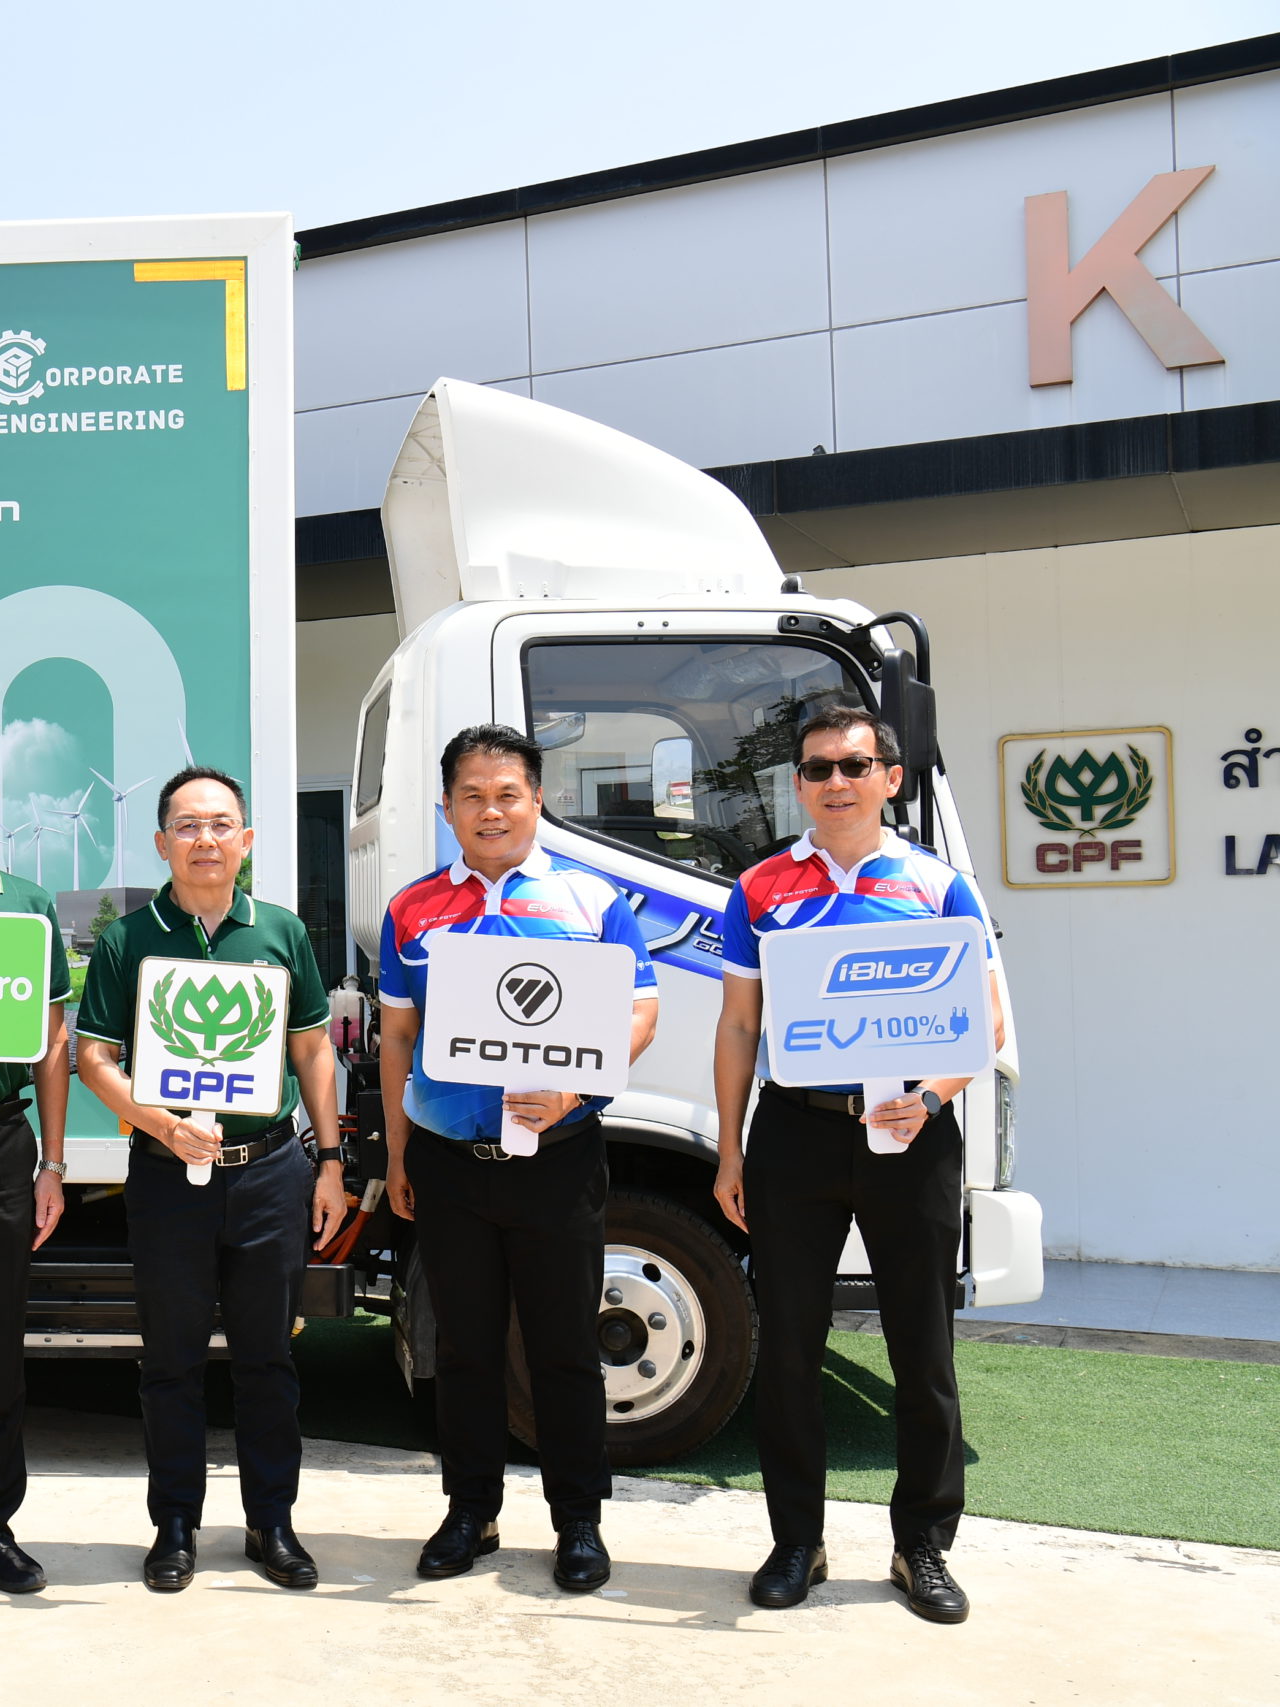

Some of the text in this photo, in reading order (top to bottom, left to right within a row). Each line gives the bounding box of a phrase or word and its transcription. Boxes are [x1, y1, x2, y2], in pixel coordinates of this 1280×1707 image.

[1024, 164, 1226, 389] K
[1035, 839, 1142, 873] CPF
[783, 1014, 946, 1052] EV 100%
[449, 1036, 604, 1071] FOTON
[159, 1068, 255, 1104] CPF
